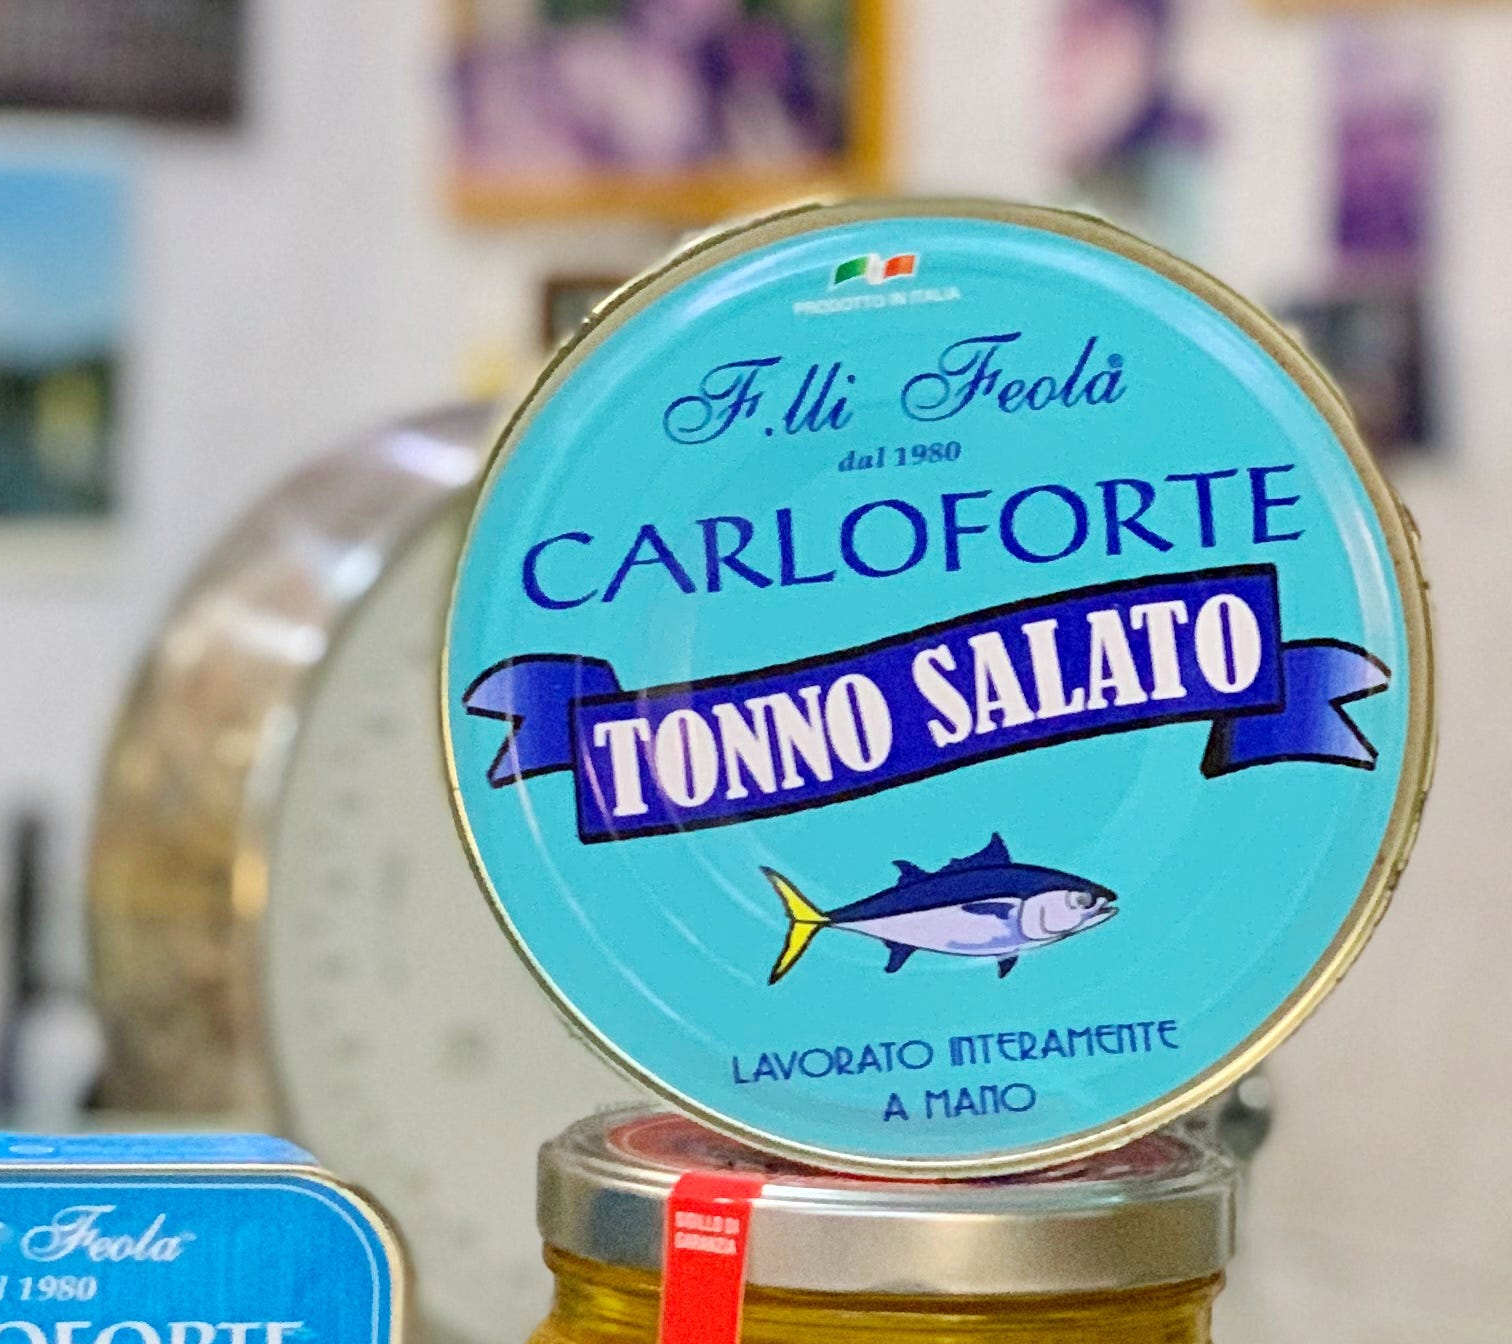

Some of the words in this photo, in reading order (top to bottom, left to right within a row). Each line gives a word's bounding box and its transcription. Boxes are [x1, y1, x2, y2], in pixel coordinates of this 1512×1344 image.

[899, 330, 1126, 423] Feola
[838, 447, 888, 474] dal
[892, 441, 963, 468] 1980
[521, 463, 1308, 610] CARLOFORTE
[594, 672, 892, 819] TONNO
[911, 592, 1264, 749] SALATO
[732, 1038, 936, 1086] LAVORATO
[949, 1018, 1182, 1068] INTERAMENTE
[883, 1091, 909, 1123] A
[923, 1081, 1037, 1117] MANO
[20, 1204, 186, 1263] Feola
[18, 1274, 98, 1302] 1980
